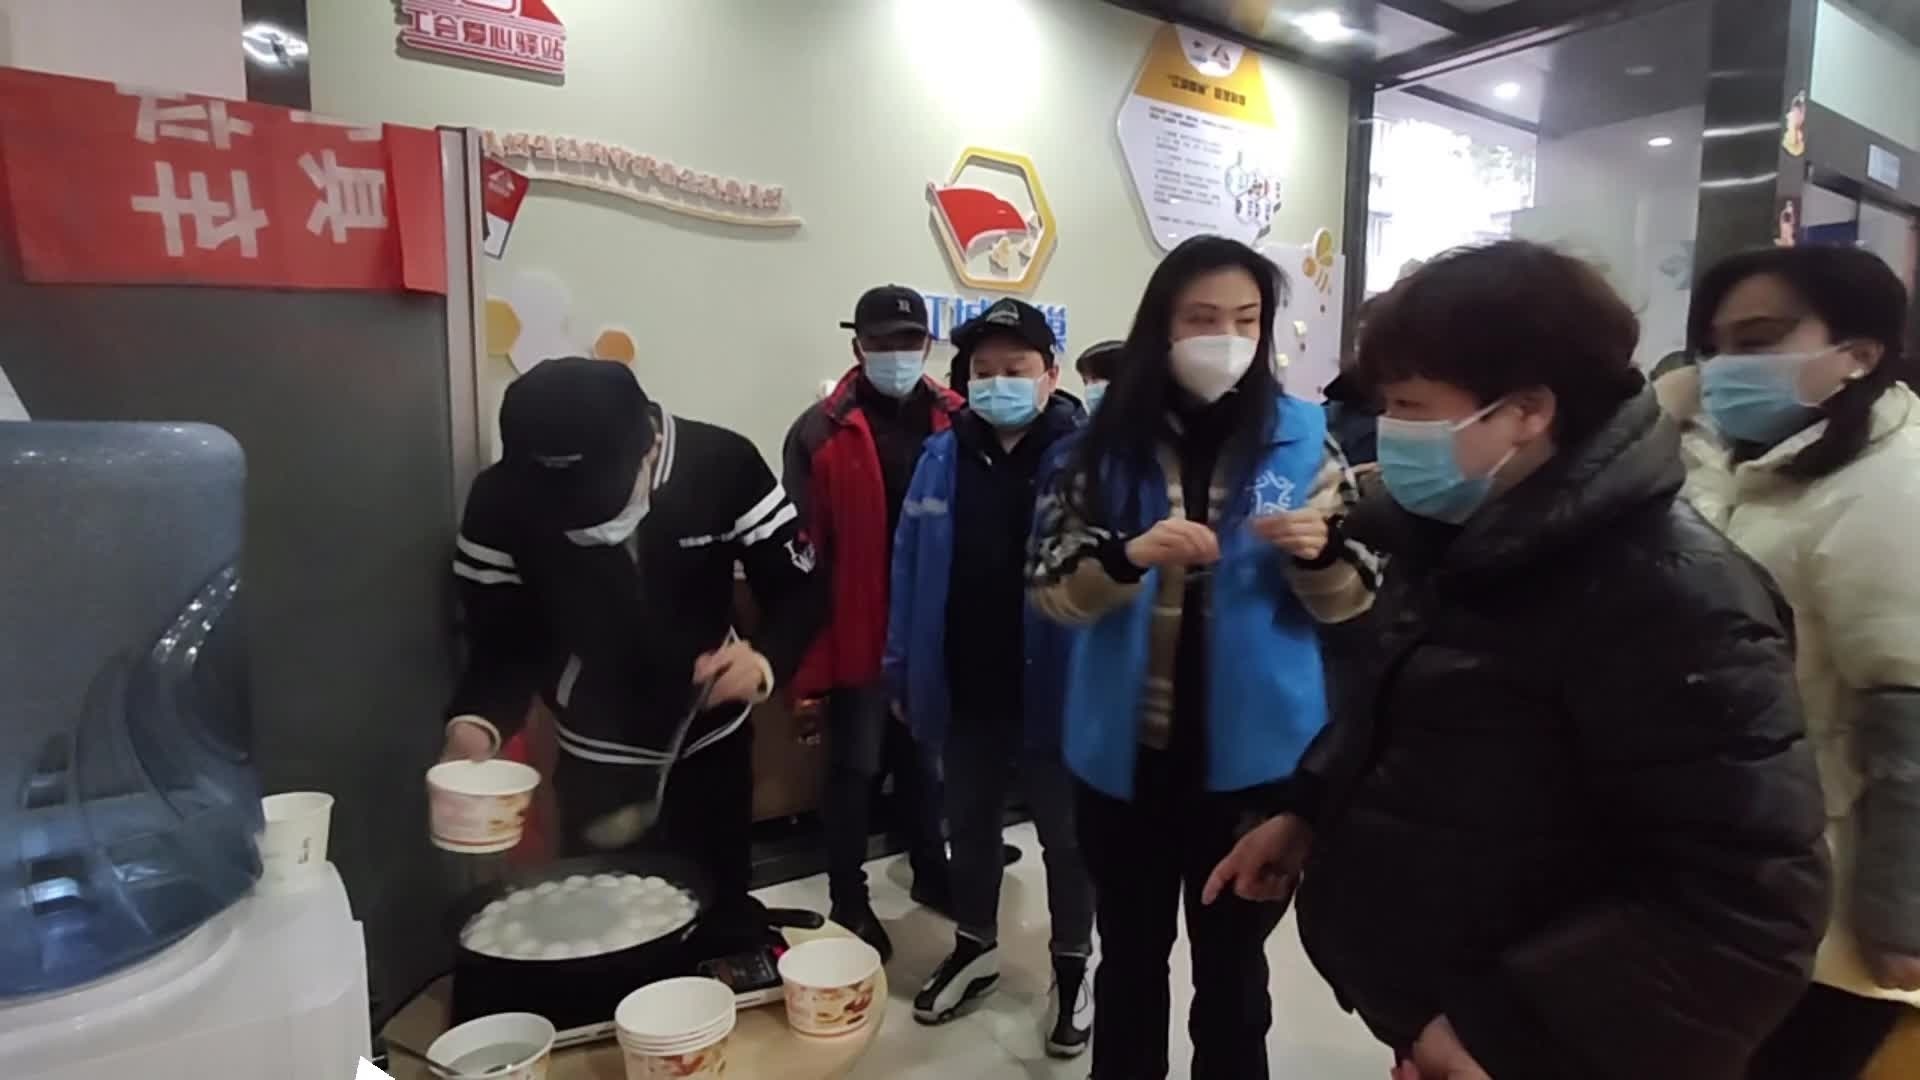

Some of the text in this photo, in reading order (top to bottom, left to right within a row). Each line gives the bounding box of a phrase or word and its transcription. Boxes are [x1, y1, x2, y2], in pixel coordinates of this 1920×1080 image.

[407, 10, 566, 63] 工会爱心驿站
